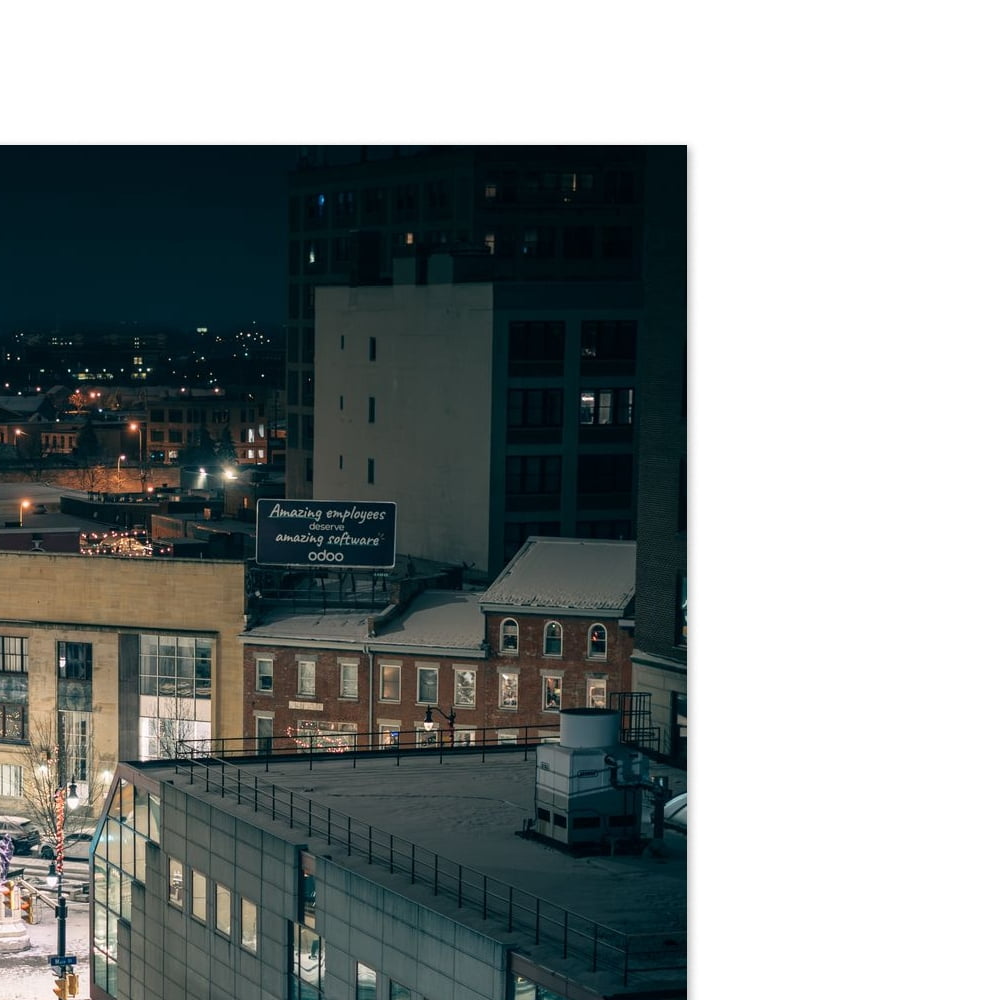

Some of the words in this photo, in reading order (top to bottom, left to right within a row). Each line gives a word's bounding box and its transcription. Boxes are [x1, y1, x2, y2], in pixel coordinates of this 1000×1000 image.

[270, 503, 322, 521] Amazing
[326, 506, 386, 524] employees
[309, 522, 345, 531] deserve
[275, 532, 323, 546] amazing
[327, 531, 380, 546] software
[308, 550, 344, 562] odoo
